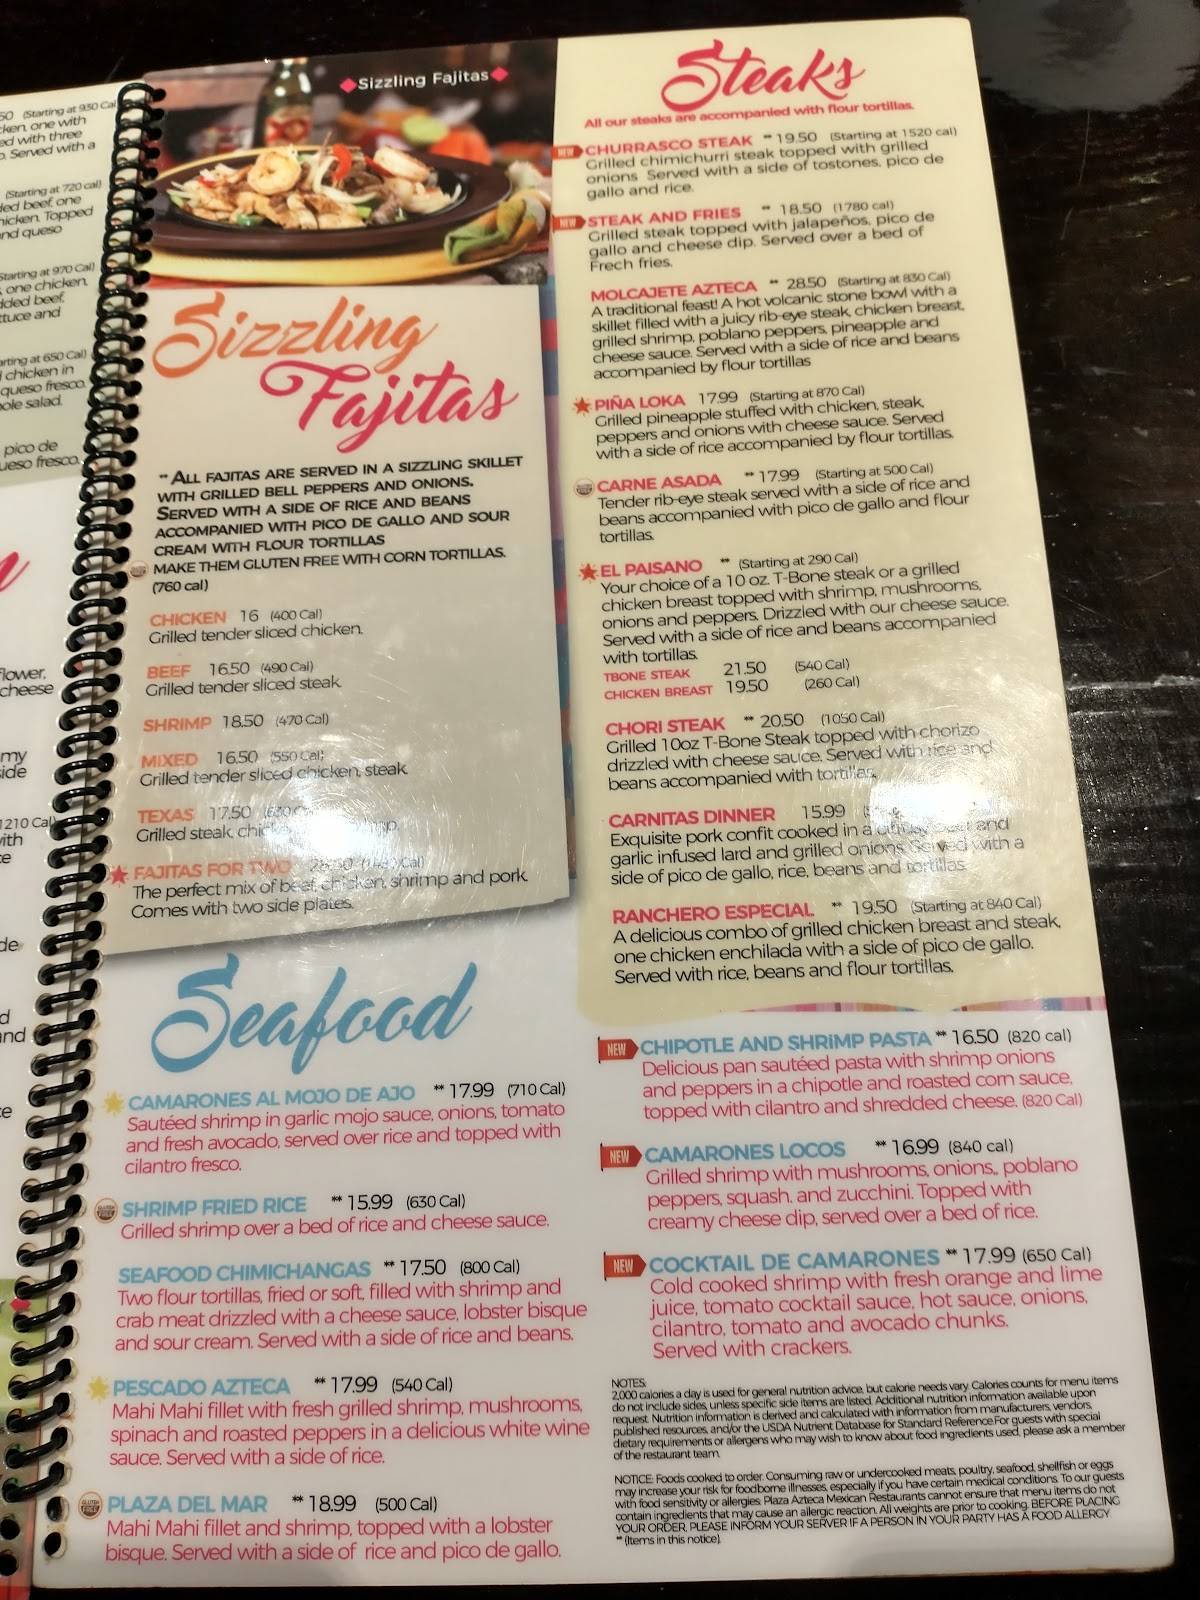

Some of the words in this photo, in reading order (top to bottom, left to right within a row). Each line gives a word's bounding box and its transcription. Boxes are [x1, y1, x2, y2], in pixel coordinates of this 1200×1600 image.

[357, 75, 426, 90] Sizzling
[432, 70, 489, 85] Fajitas
[661, 40, 864, 112] Steaks
[23, 108, 64, 120] (Starting
[66, 105, 76, 114] at
[79, 102, 98, 112] 930
[584, 117, 602, 128] All
[604, 118, 628, 127] our
[630, 114, 672, 126] steaks
[674, 112, 697, 123] are
[699, 106, 791, 121] accompanied
[793, 104, 825, 115] with
[827, 103, 859, 114] flour
[50, 130, 82, 143] three
[584, 139, 693, 156] CHURRASCO
[697, 135, 752, 149] STEAK
[778, 131, 817, 144] 19.50
[5, 188, 48, 200] (Starting
[48, 185, 60, 194] at
[62, 182, 82, 192] 720
[83, 179, 102, 190] cal)
[45, 206, 94, 222] Topped
[587, 213, 643, 228] STEAK
[648, 210, 687, 224] AND
[692, 207, 741, 221] FRIES
[781, 202, 822, 215] 18.50
[833, 201, 869, 213] (1780
[871, 200, 894, 210] cal)
[590, 284, 687, 302] MOLCAJETE
[691, 280, 757, 296] AZTECA
[786, 276, 827, 290] 28.50
[837, 275, 886, 288] (Starting
[888, 274, 900, 284] at
[902, 272, 926, 283] 830
[927, 271, 951, 281] Cal)
[152, 291, 437, 376] Sizzling
[1, 381, 42, 398] queso
[261, 361, 518, 453] Fajitas
[594, 394, 636, 411] PIÑA
[639, 394, 686, 408] LOKA
[700, 391, 738, 405] 17.99
[4, 444, 35, 458] pico
[38, 440, 58, 452] de
[596, 477, 657, 493] CARNE
[660, 473, 722, 489] ASADA
[759, 468, 800, 483] 17.99
[153, 561, 196, 574] MAKE
[198, 559, 240, 572] THEM
[242, 556, 300, 570] GLUTEN
[303, 554, 339, 567] FREE
[342, 552, 380, 565] WITH
[383, 550, 426, 563] CORN
[428, 546, 506, 561] TORTILLAS.
[600, 564, 621, 578] EL
[624, 559, 702, 576] PAISANO
[152, 580, 181, 595] (760
[183, 578, 208, 592] cal)
[149, 610, 226, 627] CHICKEN
[240, 609, 259, 622] 16
[270, 610, 297, 622] (400
[298, 608, 322, 620] Cal)
[146, 664, 190, 679] BEEF
[209, 661, 250, 676] 16.50
[603, 671, 646, 682] TBONE
[650, 668, 690, 680] STEAK
[723, 661, 766, 676] 21.50
[794, 660, 822, 673] (540
[824, 658, 849, 670] Cal)
[1, 683, 54, 698] cheese
[603, 688, 660, 700] CHICKEN
[664, 684, 713, 697] BREAST
[727, 679, 768, 693] 19.50
[142, 716, 212, 732] SHRIMP
[223, 713, 264, 728] 18.50
[605, 720, 662, 736] CHORI
[666, 717, 725, 733] STEAK
[760, 712, 804, 728] 20.50
[141, 752, 198, 768] MIXED
[217, 750, 258, 765] 16.50
[137, 807, 194, 824] TEXAS
[211, 805, 252, 821] 17.50
[608, 810, 699, 828] CARNITAS
[703, 807, 775, 824] DINNER
[804, 803, 845, 819] 15.99
[133, 863, 202, 880] FAJITAS
[206, 861, 244, 878] FOR
[247, 856, 292, 876] TWO
[612, 905, 720, 924] RANCHERO
[853, 899, 897, 915] 19.50
[910, 899, 967, 915] (Starting
[970, 899, 984, 911] at
[986, 897, 1013, 910] 840
[1014, 895, 1042, 909] Cal)
[614, 967, 671, 984] Served
[674, 965, 713, 982] with
[753, 964, 805, 979] beans
[808, 961, 842, 977] and
[846, 960, 887, 976] flour
[151, 954, 476, 1073] Seafood
[607, 1043, 626, 1056] NEW
[638, 1036, 735, 1056] CHIPOTLE
[738, 1035, 783, 1052] AND
[868, 1030, 932, 1048] PASTA
[953, 1028, 999, 1045] 16.50
[127, 1091, 252, 1111] CAMARONES
[255, 1090, 280, 1107] AL
[284, 1088, 341, 1105] MOJO
[345, 1086, 372, 1103] DE
[375, 1084, 416, 1102] AJO
[450, 1082, 494, 1099] 17.99
[507, 1083, 537, 1099] (710
[539, 1081, 566, 1096] Cal)
[609, 1150, 629, 1163] NEW
[644, 1143, 775, 1163] CAMARONES
[779, 1141, 846, 1159] LOCOS
[893, 1138, 939, 1156] 16.99
[121, 1199, 197, 1218] SHRIMP
[201, 1198, 258, 1216] FRIED
[262, 1196, 307, 1214] RICE
[348, 1193, 393, 1211] 15.99
[406, 1195, 436, 1210] (630
[439, 1193, 465, 1209] Cal)
[613, 1258, 633, 1273] NEW
[648, 1254, 755, 1274] COCKTAIL
[761, 1253, 791, 1271] DE
[796, 1248, 940, 1270] CAMARONES
[963, 1246, 1016, 1264] 17.99
[118, 1265, 212, 1284] SEAFOOD
[215, 1260, 371, 1282] CHIMICHANGAS
[401, 1258, 446, 1276] 17.50
[653, 1340, 717, 1359] Served
[722, 1338, 765, 1357] with
[770, 1337, 852, 1356] crackers.
[112, 1378, 207, 1397] PESCADO
[210, 1377, 291, 1396] AZTECA
[332, 1375, 377, 1393] 17.99
[613, 1449, 624, 1461] of
[624, 1449, 641, 1460] the
[643, 1449, 691, 1460] restaurant
[107, 1495, 173, 1514] PLAZA
[177, 1495, 216, 1514] DEL
[220, 1495, 268, 1513] MAR
[310, 1494, 356, 1512] 18.99
[375, 1497, 407, 1514] (500
[409, 1496, 437, 1513] Cal)
[615, 1523, 645, 1533] YOUR
[689, 1521, 728, 1532] PLEASE
[730, 1519, 771, 1531] INFORM
[773, 1519, 804, 1529] YOUR
[806, 1518, 847, 1529] SERVER
[656, 1534, 666, 1544] in
[667, 1534, 685, 1544] this
